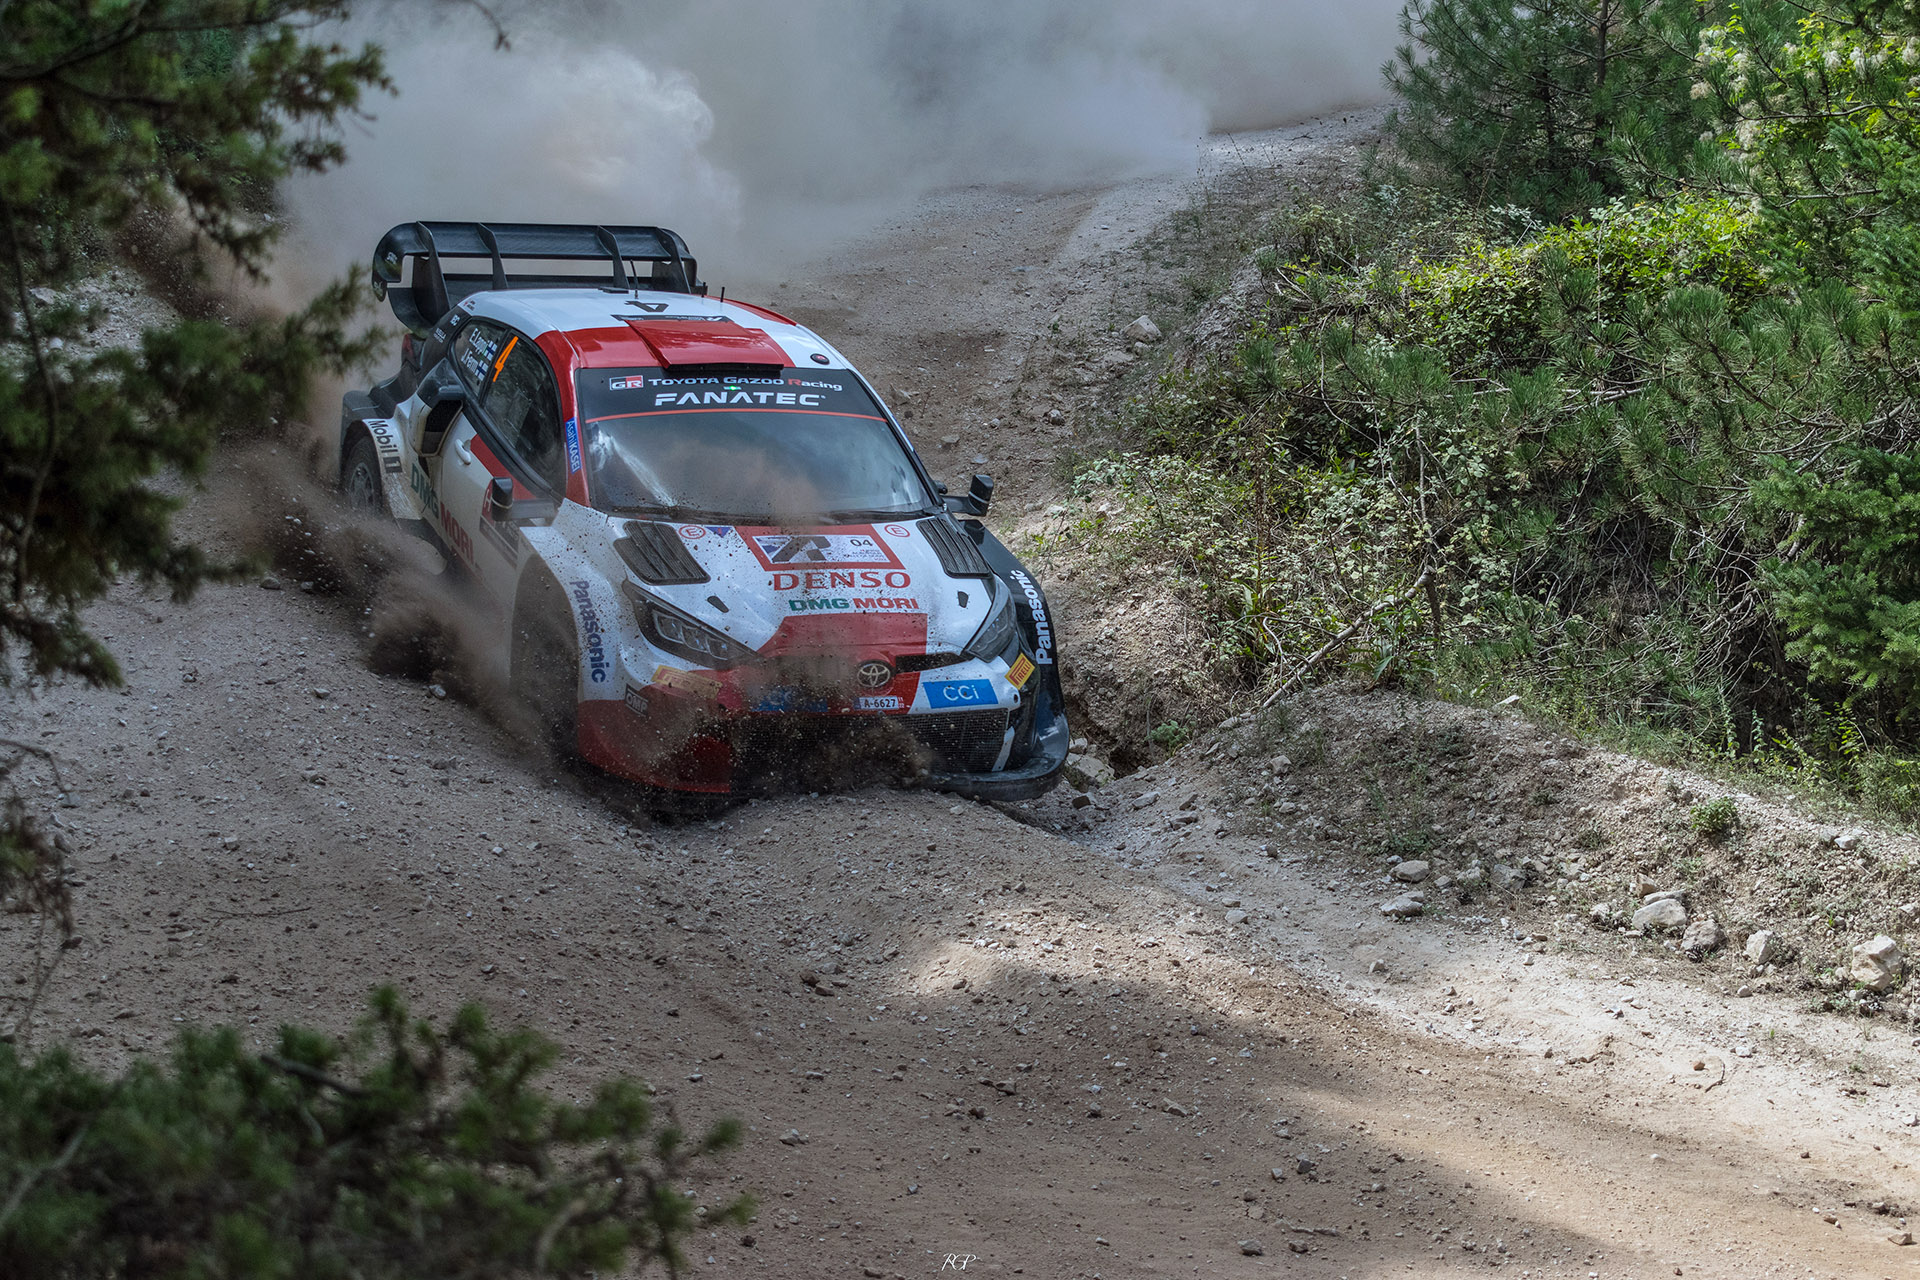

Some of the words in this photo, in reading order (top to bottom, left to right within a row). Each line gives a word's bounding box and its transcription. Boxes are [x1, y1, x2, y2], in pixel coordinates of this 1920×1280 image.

[611, 378, 643, 389] GR
[648, 377, 719, 386] TOYOTA
[788, 378, 843, 392] Racing
[654, 391, 820, 406] FANATEC
[368, 420, 398, 453] Mobil
[850, 538, 874, 547] 04
[773, 571, 912, 591] DENSO
[789, 598, 850, 612] DMG
[852, 597, 919, 611] MORI
[1010, 569, 1053, 665] Panasonic
[569, 580, 611, 684] Panasonic
[864, 698, 896, 709] A-6627
